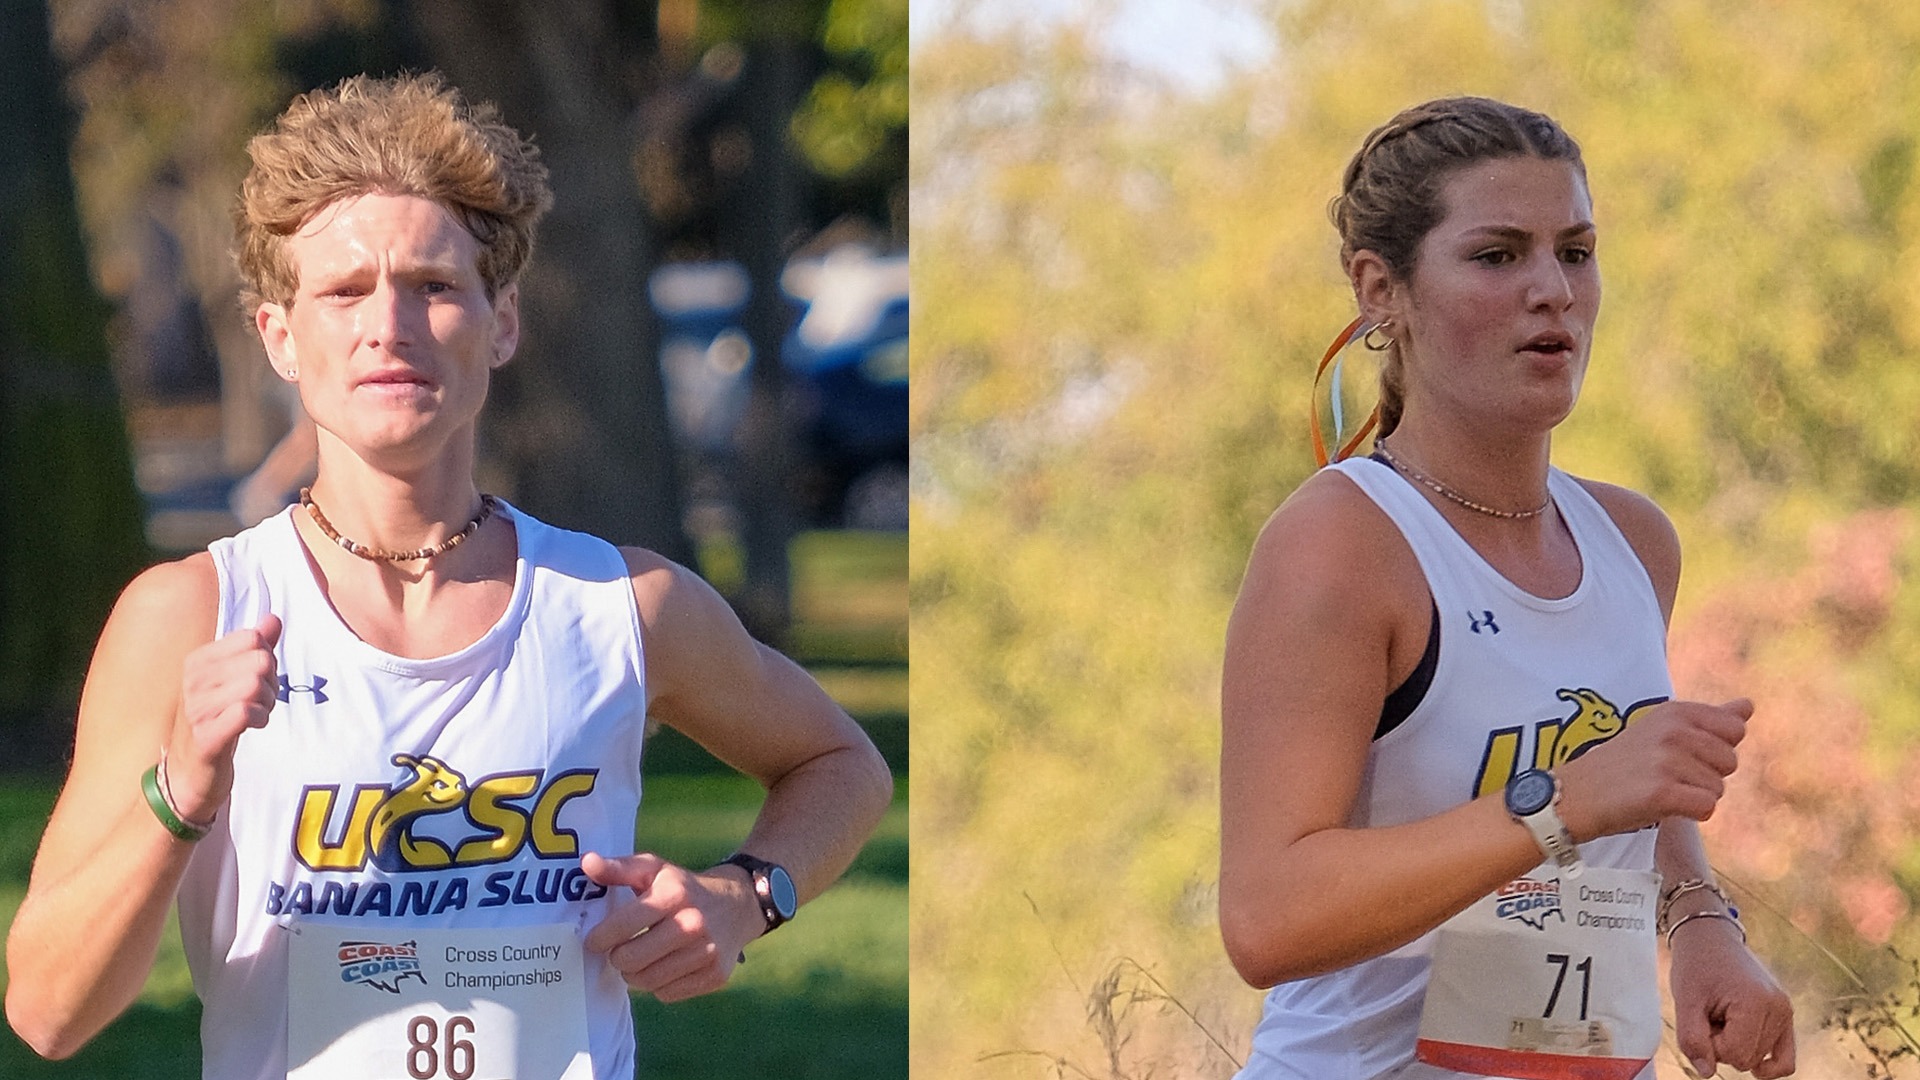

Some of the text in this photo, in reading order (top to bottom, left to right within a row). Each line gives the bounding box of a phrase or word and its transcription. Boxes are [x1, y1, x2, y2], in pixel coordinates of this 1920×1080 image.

[291, 753, 600, 873] UCSC
[265, 877, 468, 917] BANANA
[1580, 885, 1614, 904] Cross
[1496, 897, 1561, 918] COAST
[338, 946, 417, 961] COAST
[445, 944, 562, 963] Cross Country
[341, 960, 420, 983] COAST
[444, 968, 563, 991] Championships
[1542, 953, 1593, 1020] 71
[1511, 1020, 1524, 1033] 71
[406, 1015, 476, 1080] 86
